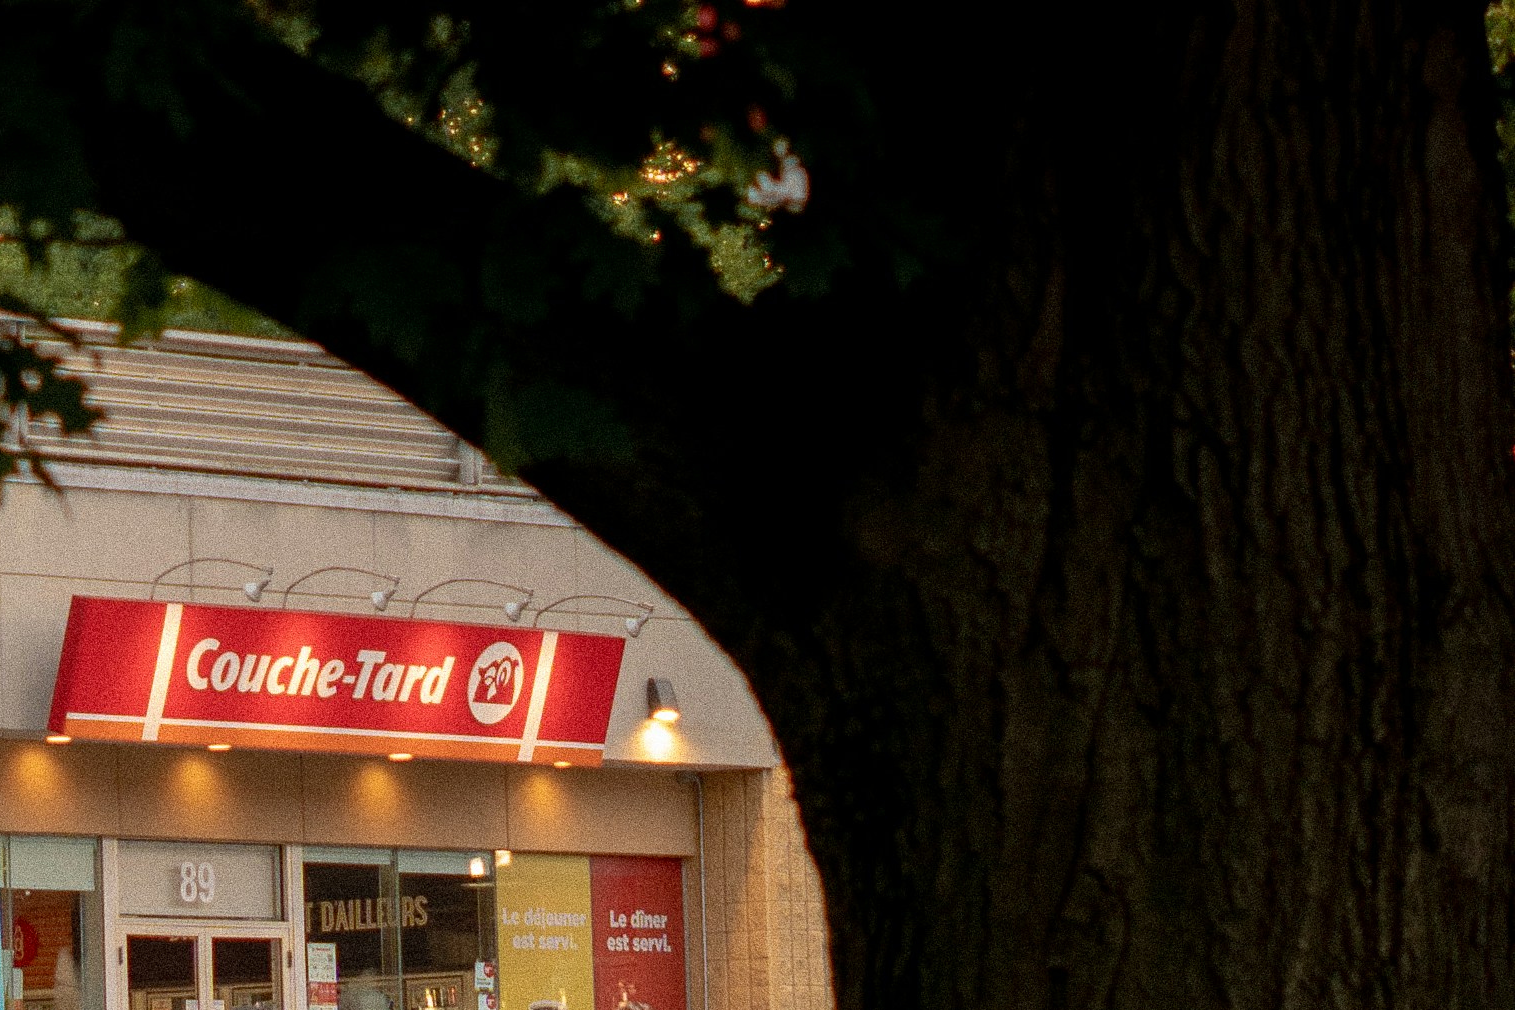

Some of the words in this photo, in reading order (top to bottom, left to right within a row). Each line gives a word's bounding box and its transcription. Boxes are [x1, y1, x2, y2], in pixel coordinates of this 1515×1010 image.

[186, 638, 456, 704] Couche-Tard
[179, 861, 215, 902] 89
[321, 896, 428, 932] D'AILLEURS
[501, 907, 519, 926] Le
[524, 907, 587, 929] déjeuner
[610, 910, 627, 928] Le
[630, 909, 667, 929] dîner
[512, 933, 535, 950] est
[538, 933, 577, 951] servi.
[607, 935, 629, 952] est
[633, 934, 672, 952] servi.
